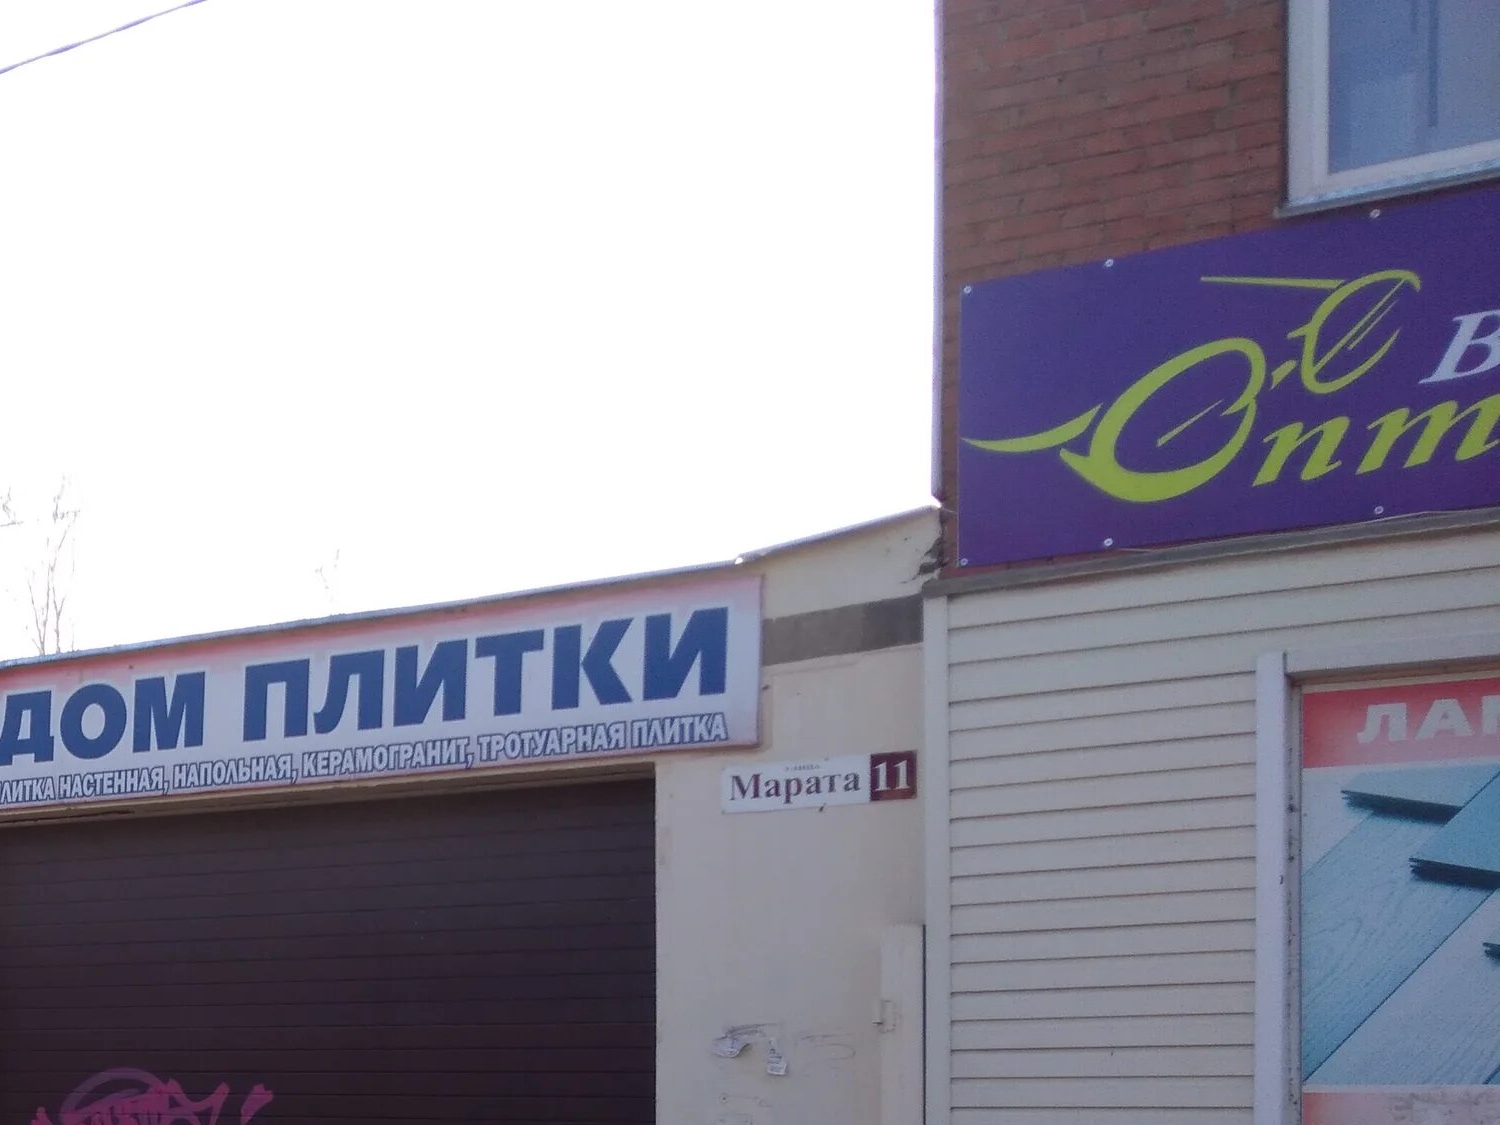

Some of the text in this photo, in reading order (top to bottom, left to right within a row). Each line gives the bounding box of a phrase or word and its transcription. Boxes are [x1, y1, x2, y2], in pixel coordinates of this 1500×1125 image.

[244, 606, 729, 741] ПЛИТКИ
[58, 765, 169, 798] НАСТЕННАЯ,
[172, 752, 298, 788] НАПОЛЬНАЯ,
[301, 737, 475, 779] КЕРАМОГРАНИТ,
[477, 720, 627, 764] ТРОТУАРНАЯ
[630, 711, 728, 747] ПЛИТКА
[729, 759, 911, 804] Марата 11
